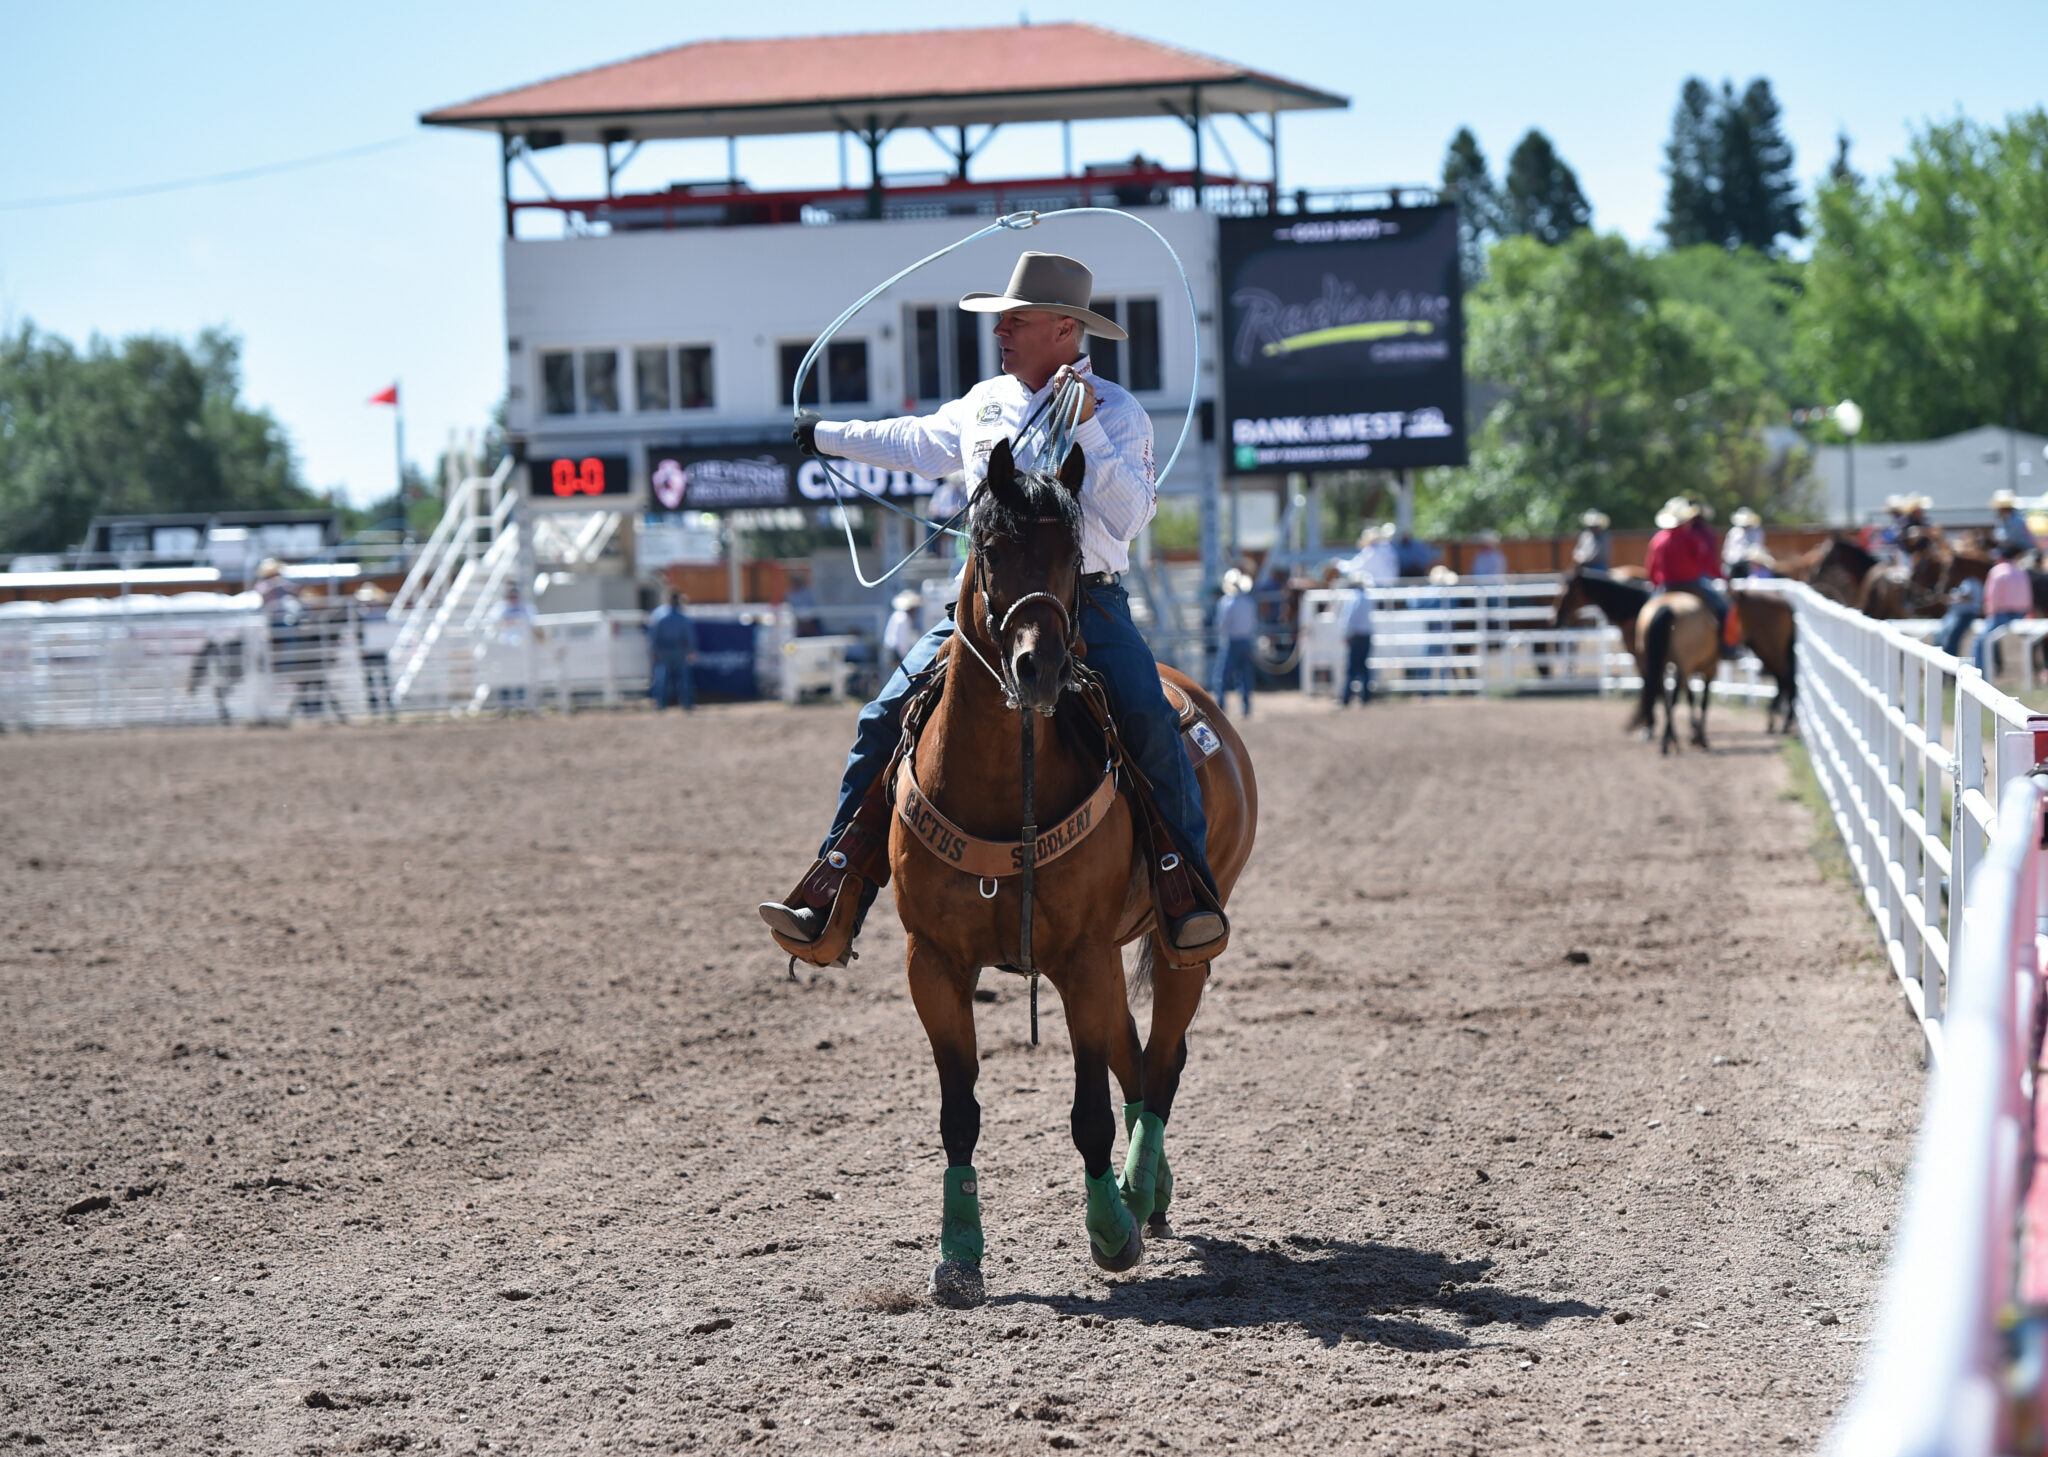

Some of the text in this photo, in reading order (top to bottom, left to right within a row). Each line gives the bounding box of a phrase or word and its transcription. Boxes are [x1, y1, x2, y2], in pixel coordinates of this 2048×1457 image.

[1233, 416, 1306, 445] BANK
[1329, 411, 1406, 441] WEST
[905, 789, 967, 862] CACTUS
[1011, 802, 1092, 869] SDDLERY
